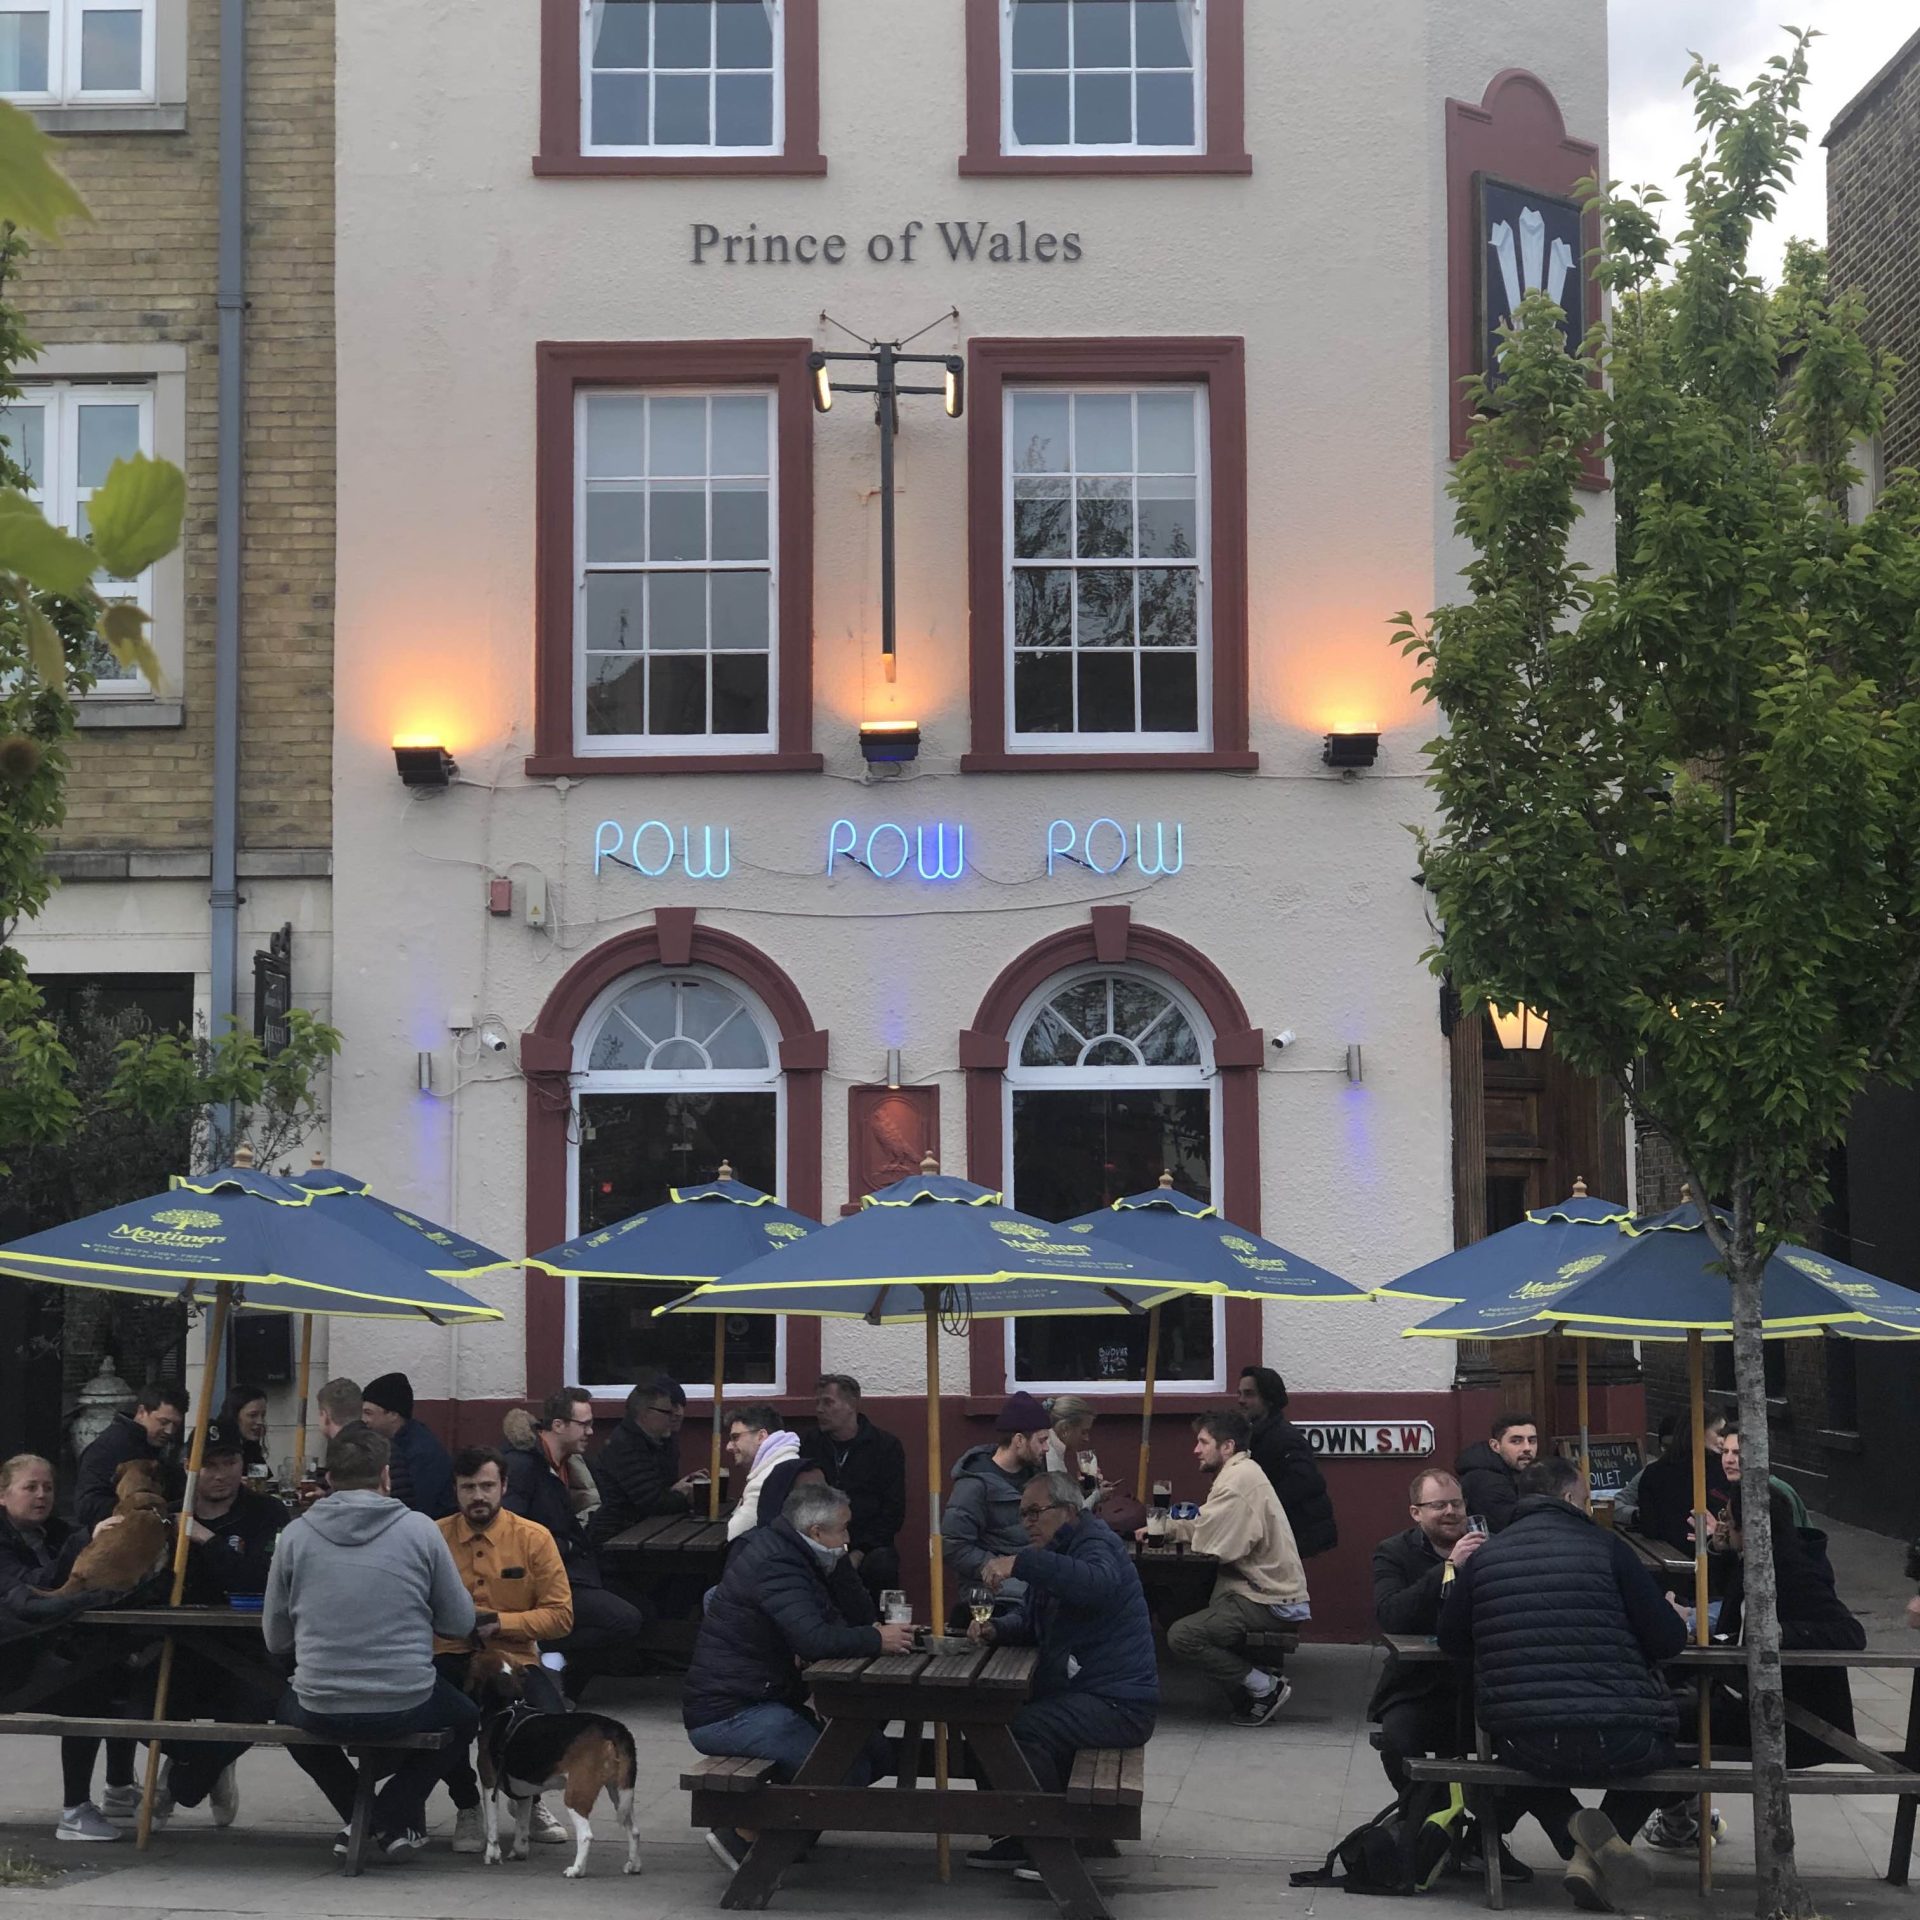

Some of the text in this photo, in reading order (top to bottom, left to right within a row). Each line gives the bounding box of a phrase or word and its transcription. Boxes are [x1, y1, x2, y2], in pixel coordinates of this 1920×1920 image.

[689, 220, 1082, 264] Prince of Wales
[594, 818, 1182, 879] ROW ROW ROW
[1589, 1470, 1621, 1487] OILET
